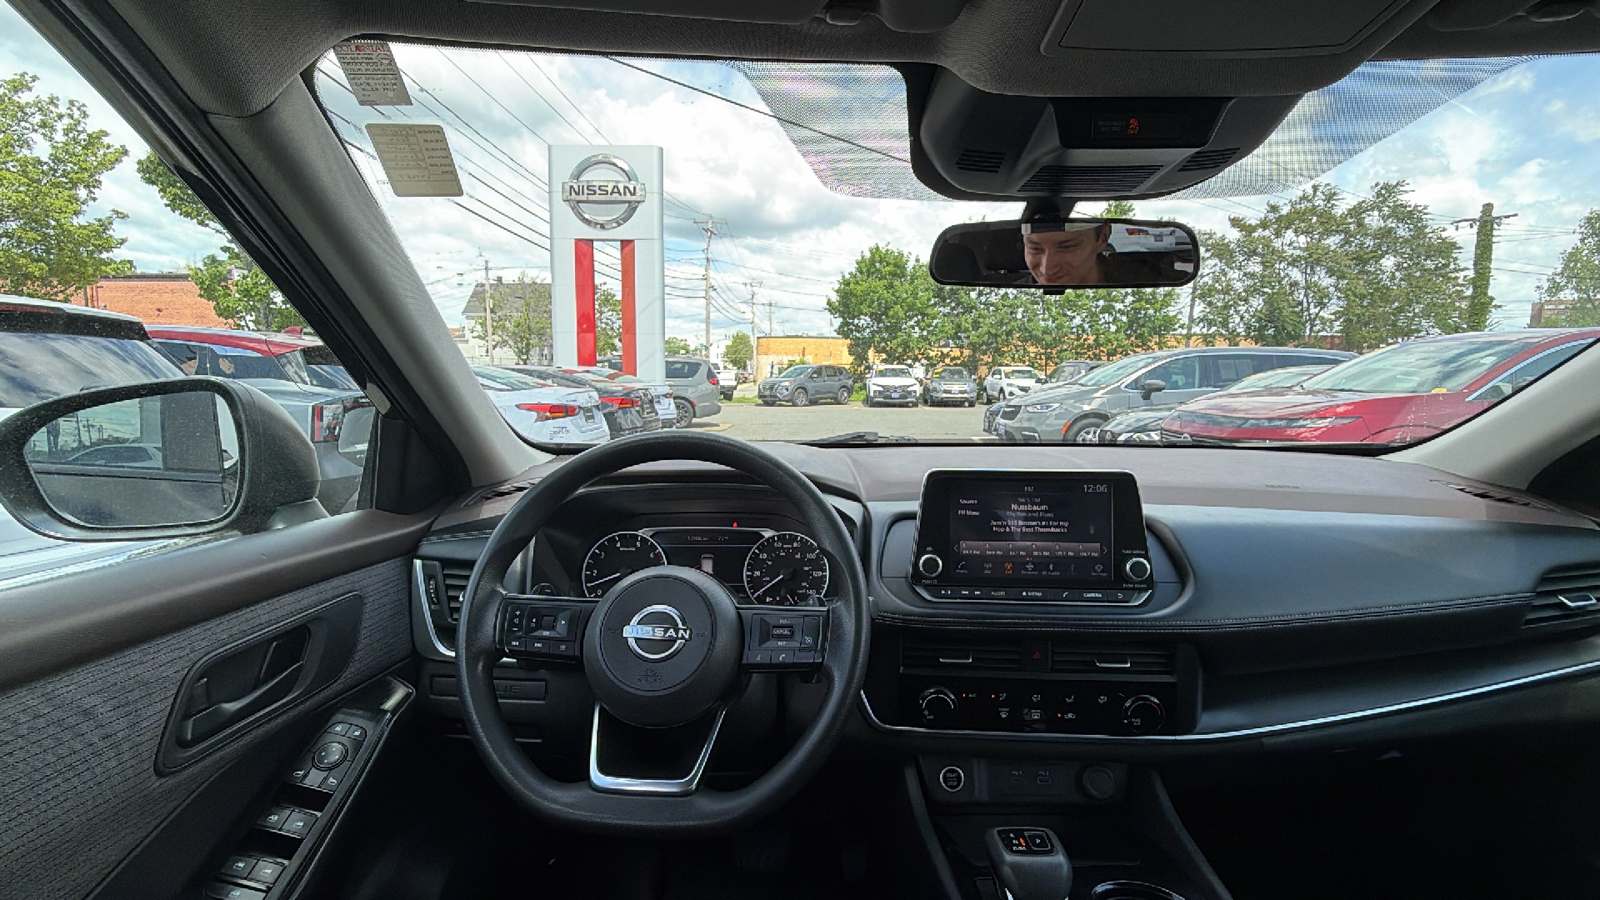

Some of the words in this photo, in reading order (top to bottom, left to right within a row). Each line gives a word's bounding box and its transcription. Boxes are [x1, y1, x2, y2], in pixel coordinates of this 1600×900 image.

[569, 184, 636, 196] NISSAN
[1083, 484, 1108, 492] 12:06
[624, 627, 690, 639] NISSAN
